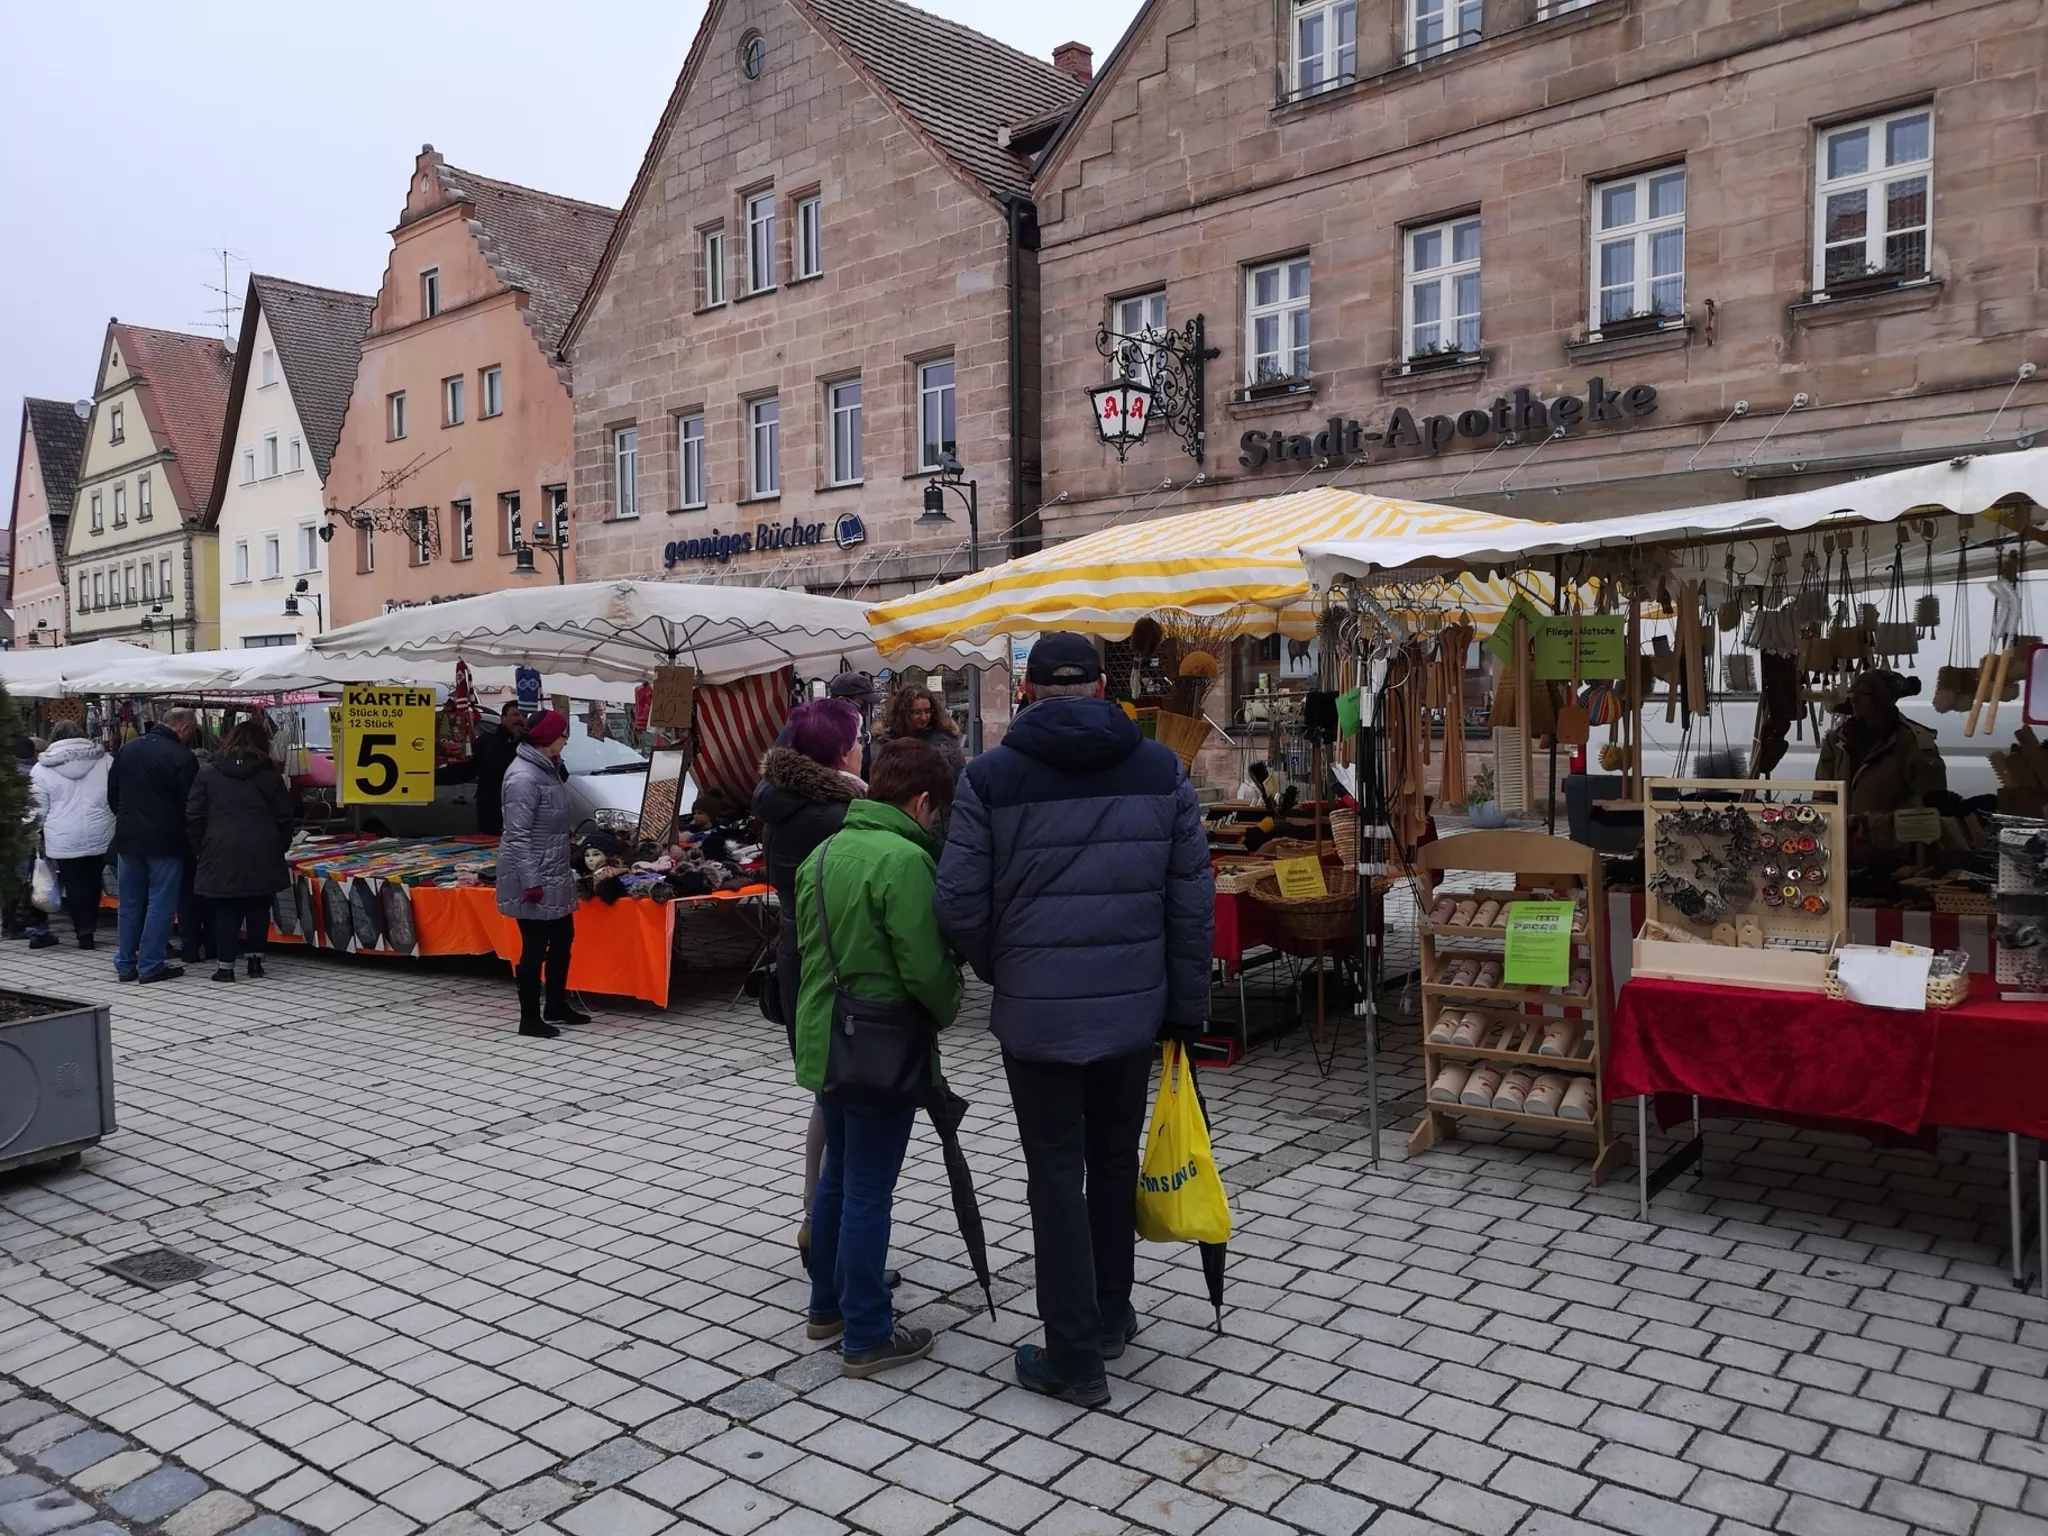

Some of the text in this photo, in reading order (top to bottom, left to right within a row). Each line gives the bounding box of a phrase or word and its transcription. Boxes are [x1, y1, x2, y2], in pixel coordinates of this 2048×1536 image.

[1239, 376, 1658, 469] Stadt-Apotheke
[664, 517, 825, 568] genniges Bücher
[1545, 626, 1616, 638] Fliegeklatsche
[348, 692, 431, 706] KARTEN
[349, 708, 403, 718] Stück 0,50
[349, 720, 394, 728] 12 Stück
